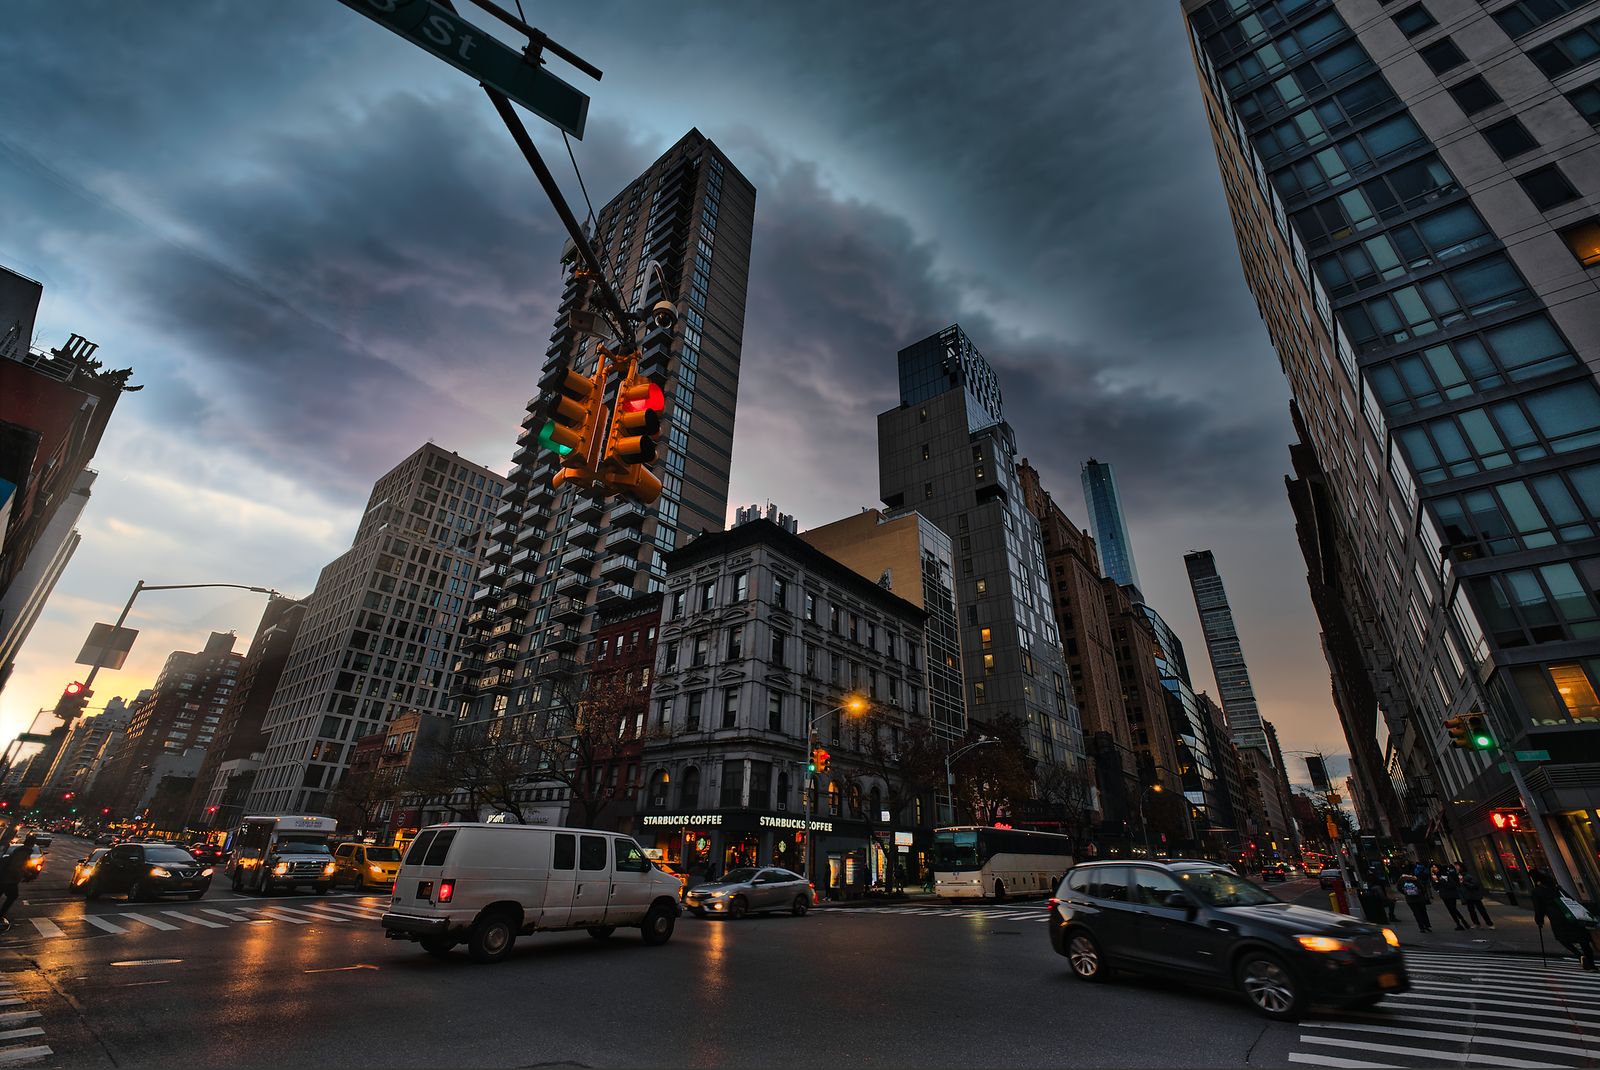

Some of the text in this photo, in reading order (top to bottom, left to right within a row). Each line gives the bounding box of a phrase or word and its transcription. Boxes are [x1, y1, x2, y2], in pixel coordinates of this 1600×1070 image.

[422, 15, 477, 60] St
[643, 815, 722, 825] STARBUCKS COFFEE
[760, 816, 806, 829] STARBUCKS
[1507, 814, 1518, 827] 2
